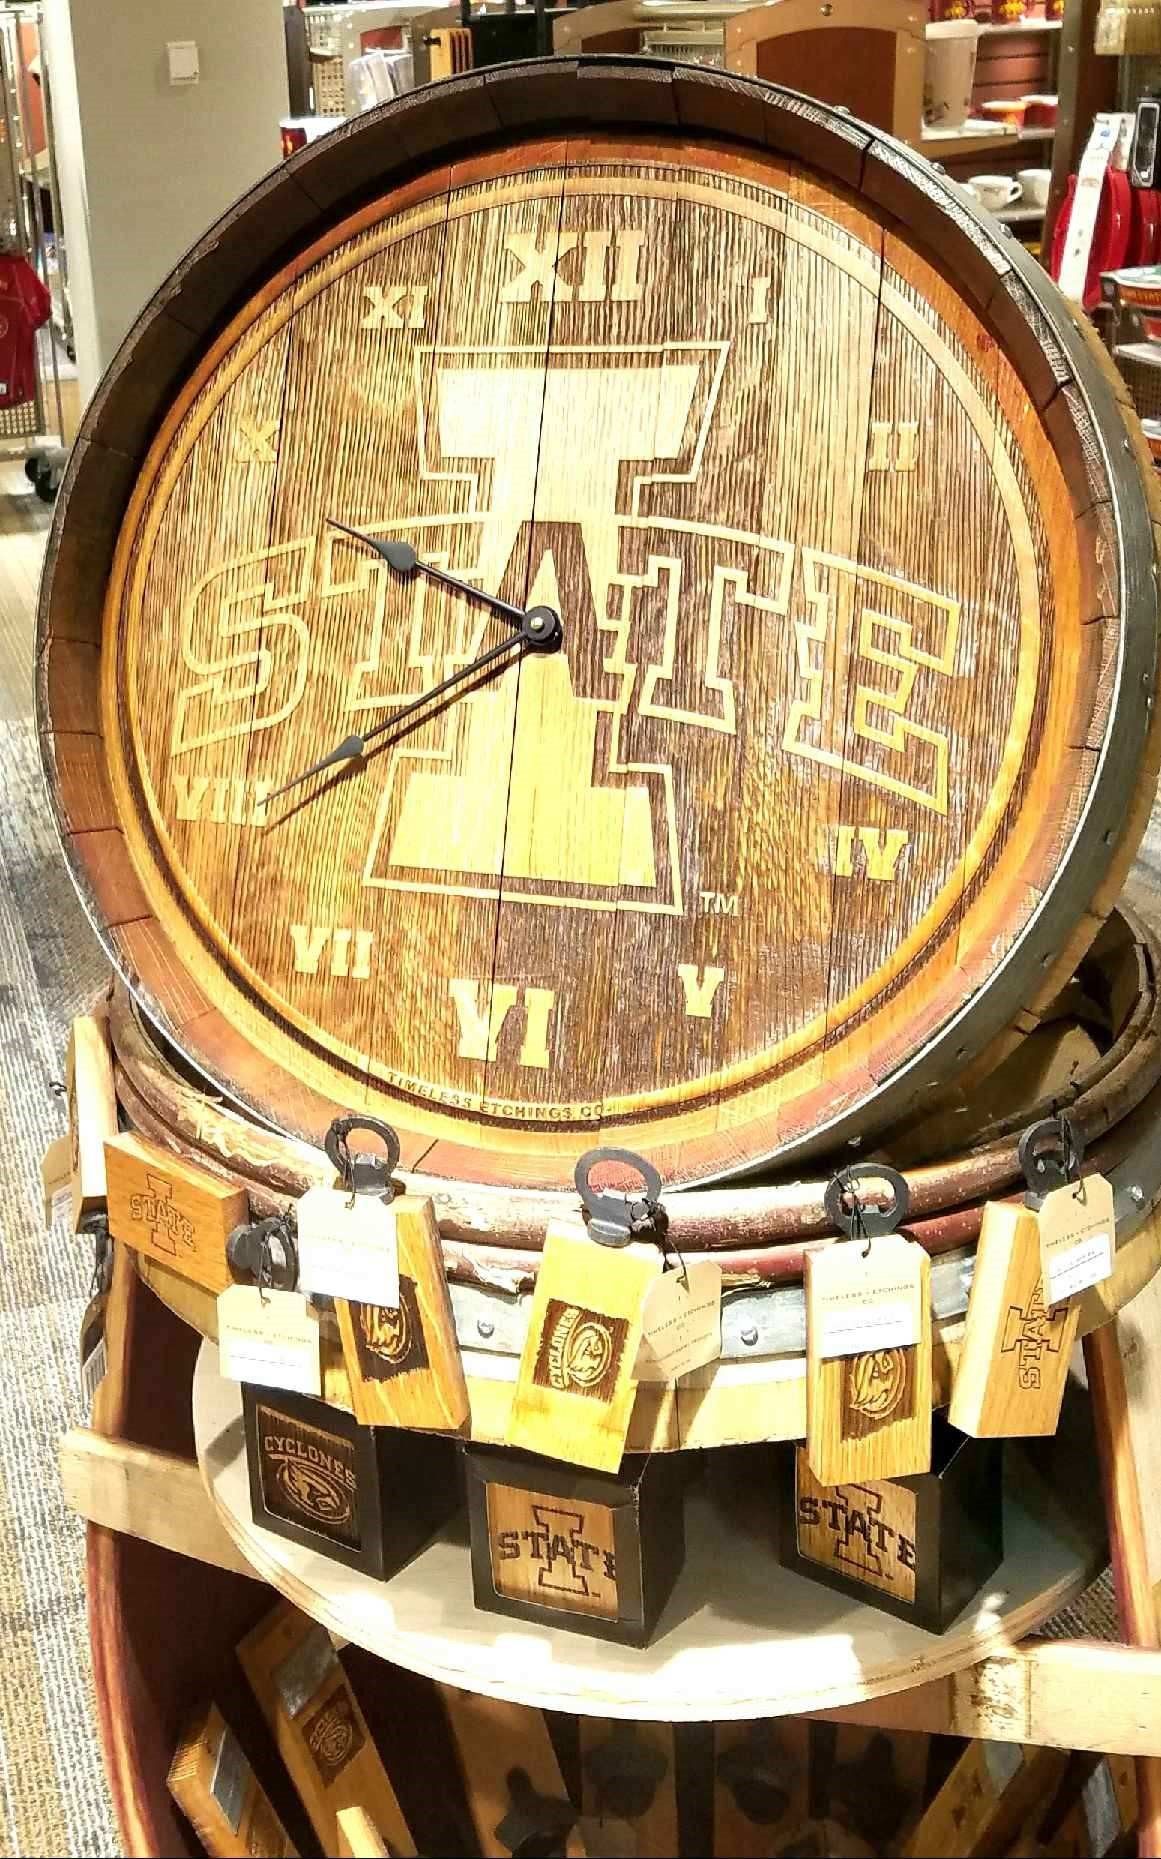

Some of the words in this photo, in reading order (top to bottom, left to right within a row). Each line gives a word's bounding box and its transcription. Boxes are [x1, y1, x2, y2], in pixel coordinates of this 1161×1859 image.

[500, 231, 645, 303] XII
[361, 285, 427, 329] XI
[748, 276, 771, 324] I
[868, 422, 919, 472] II
[171, 513, 962, 816] STATE
[172, 774, 272, 828] VIII
[834, 826, 909, 882] IV
[700, 892, 739, 917] TM
[290, 925, 373, 980] VII
[678, 964, 726, 1018] V
[450, 979, 555, 1069] VI
[387, 1071, 472, 1110] TIMELESS
[480, 1102, 572, 1120] ETCHINGS
[129, 1193, 195, 1247] STATE
[264, 1436, 358, 1490] CYCLONES
[799, 1497, 917, 1572] STATE
